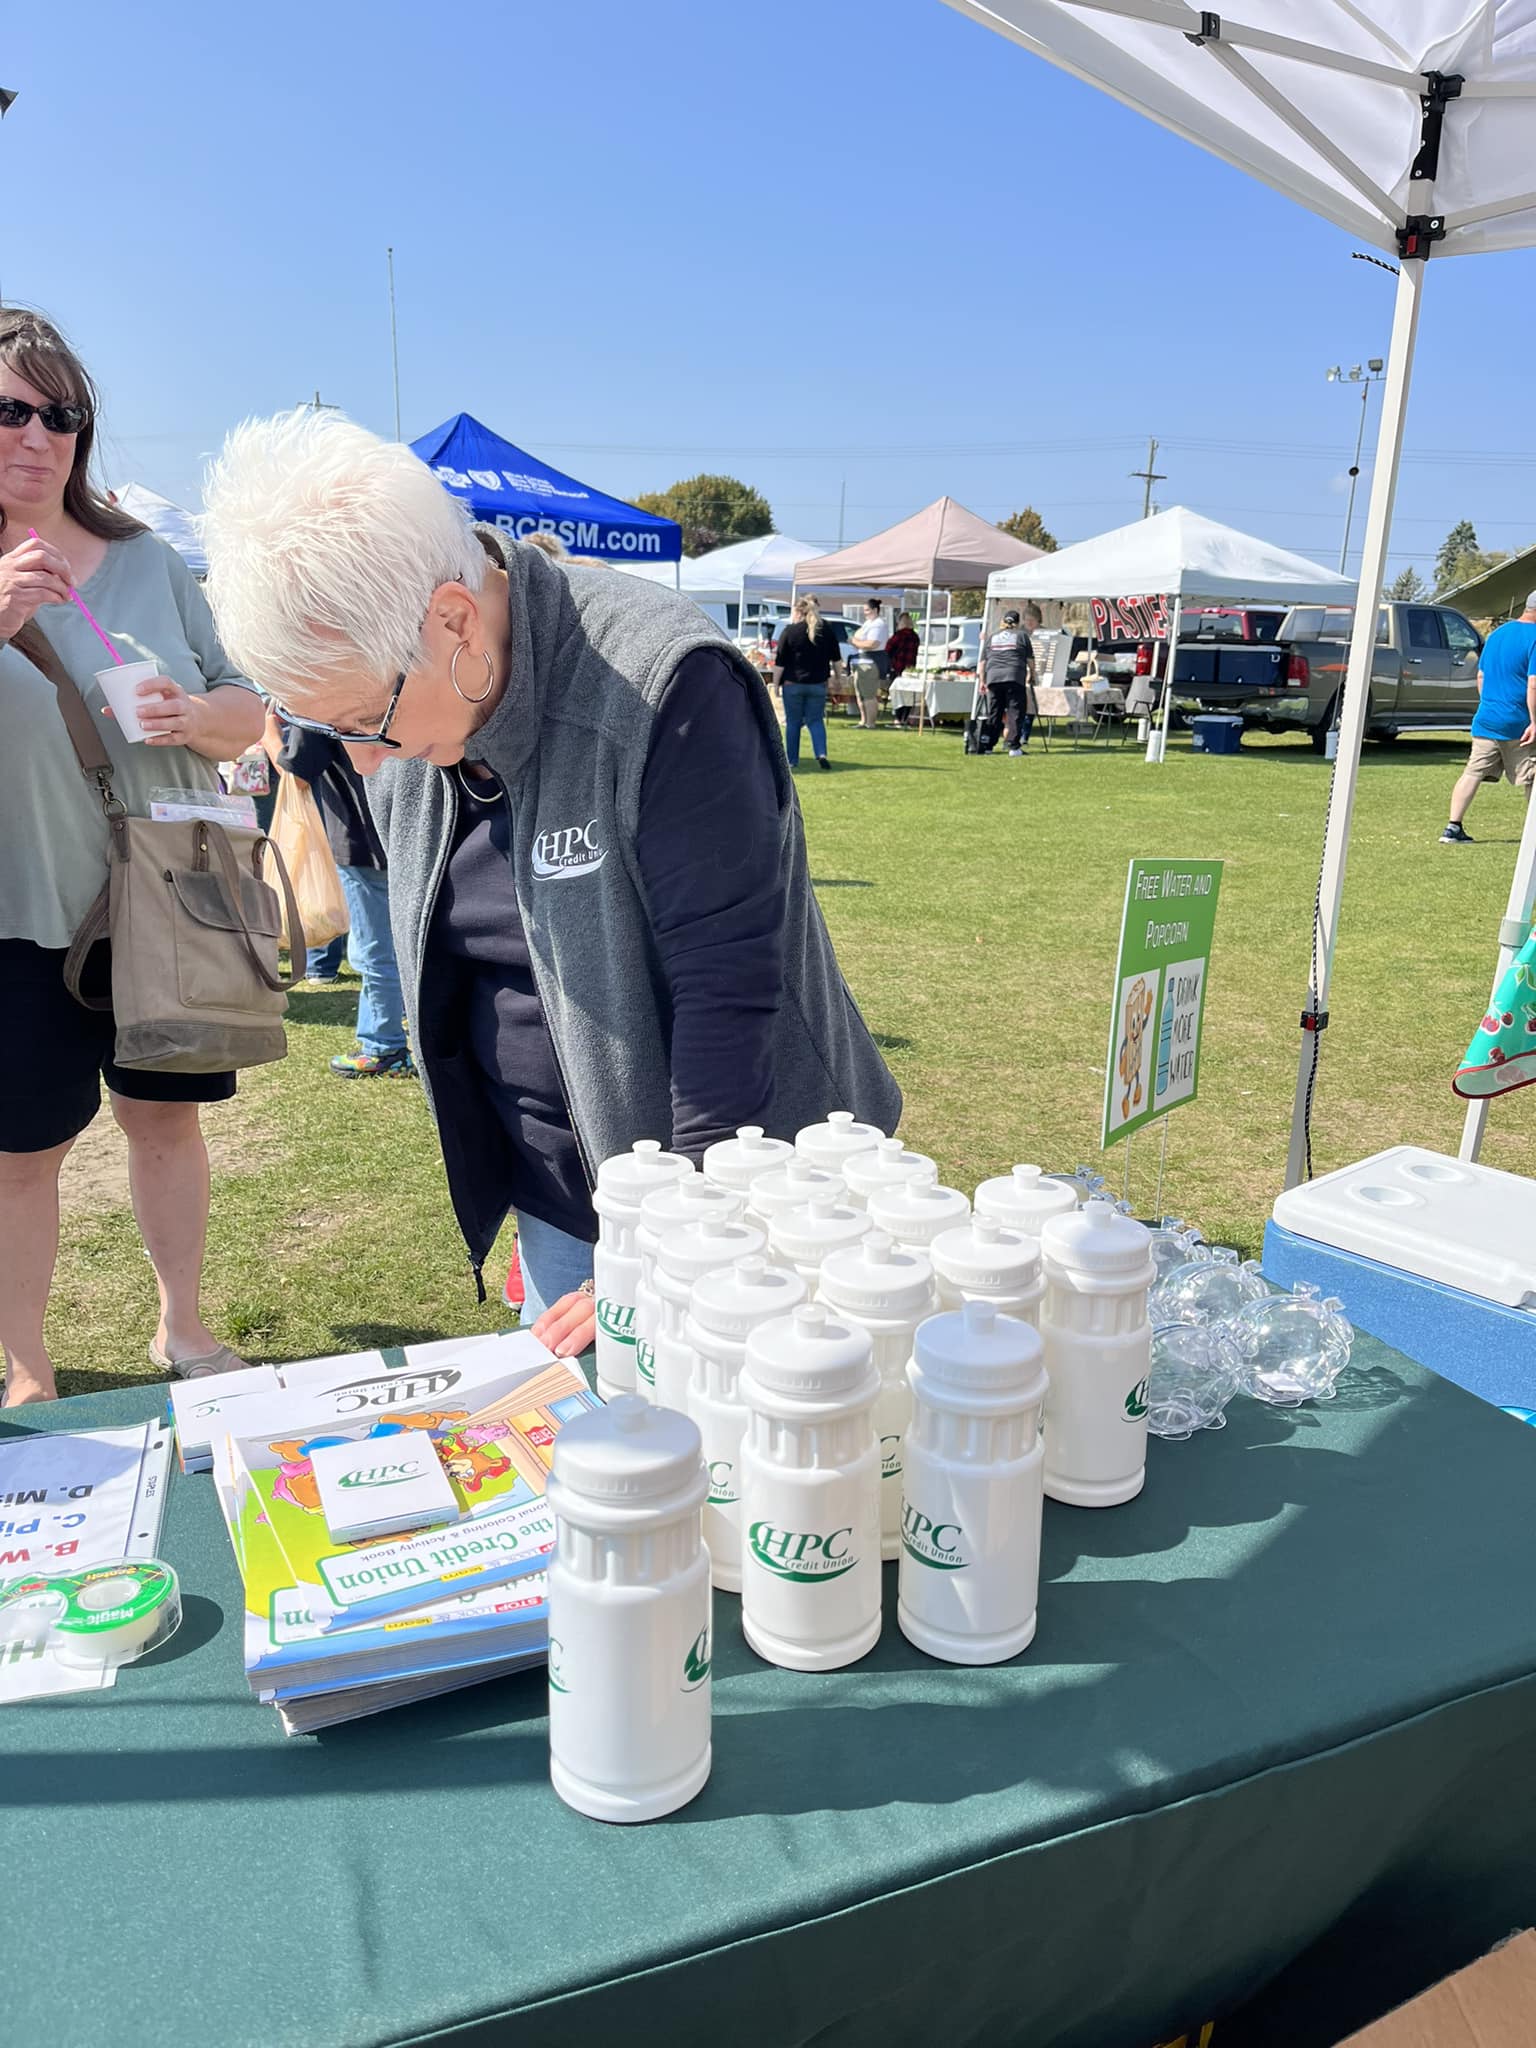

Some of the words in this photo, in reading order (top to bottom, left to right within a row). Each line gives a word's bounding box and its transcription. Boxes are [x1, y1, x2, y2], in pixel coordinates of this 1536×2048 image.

[540, 819, 599, 863] HPC
[336, 1377, 442, 1413] HPC
[355, 1460, 420, 1482] HPC
[60, 1485, 94, 1499] D.
[519, 1501, 549, 1518] ional
[53, 1513, 87, 1529] C.
[462, 1515, 516, 1534] Coloring
[519, 1518, 553, 1535] the
[45, 1540, 80, 1557] B.
[400, 1535, 446, 1552] Activity
[430, 1532, 518, 1567] Credit
[761, 1526, 853, 1561] HPC
[361, 1548, 396, 1562] Book
[822, 1555, 854, 1570] Union
[336, 1557, 430, 1589] Union
[498, 1598, 540, 1611] STOP
[87, 1608, 135, 1624] Magic
